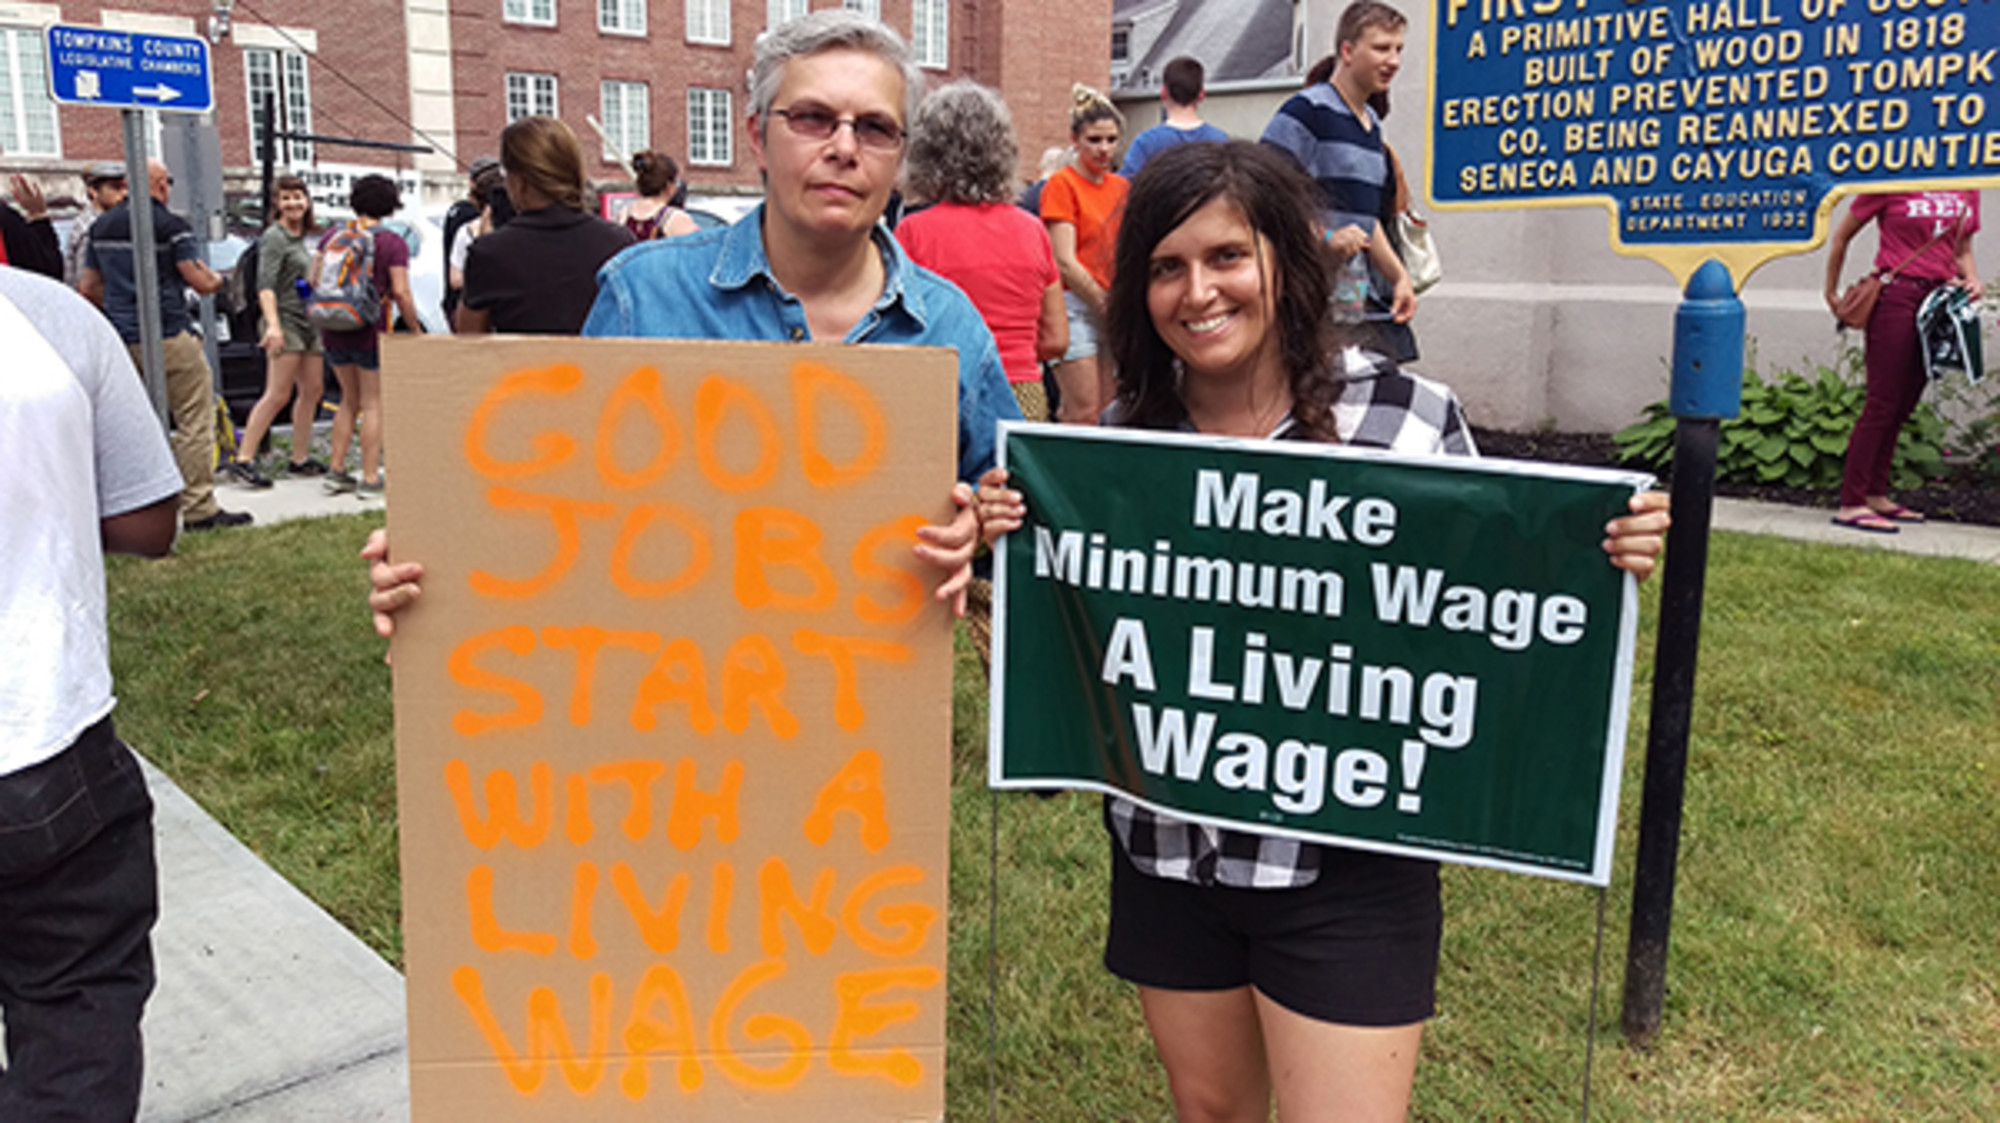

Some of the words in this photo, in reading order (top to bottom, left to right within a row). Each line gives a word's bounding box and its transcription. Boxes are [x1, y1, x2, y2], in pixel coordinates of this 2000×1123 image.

[53, 30, 133, 54] TOMPKINS
[142, 39, 201, 59] COUNTY
[1467, 30, 1486, 58] A
[1501, 7, 1668, 54] PRIMITIVE
[1687, 0, 1781, 33] HALL
[1801, 0, 1846, 20] OF
[1525, 50, 1613, 86] BUILT
[1631, 44, 1674, 75] OF
[1696, 30, 1803, 69] WOOD
[1824, 23, 1860, 58] IN
[1881, 13, 1965, 51] 1818
[1443, 89, 1595, 127] ERECTION
[1610, 66, 1828, 114] PREVENTED
[1848, 48, 1998, 94] TOMPK
[1499, 128, 1547, 155] CO.
[1565, 118, 1661, 152] BEING
[1678, 99, 1909, 145] REANNEXED
[1932, 93, 1985, 128] TO
[1460, 159, 1577, 192] SENECA
[1590, 154, 1658, 185] AND
[1671, 145, 1812, 181] CAYUGA
[1828, 131, 2000, 172] COUNTIE
[1629, 194, 1684, 211] STATE
[1701, 190, 1807, 209] EDUCATION
[1626, 213, 1746, 231] DEPARTMENT
[464, 360, 888, 492] GOOD
[1193, 468, 1398, 546] Make
[468, 484, 931, 624] JOBS
[1034, 526, 1344, 616] Minimum
[1371, 562, 1588, 650] Wage
[447, 623, 914, 740] START
[1101, 617, 1156, 691] A
[1187, 625, 1478, 748] Living
[444, 758, 745, 850] WITH
[803, 747, 891, 852] A
[1131, 703, 1430, 814] Wage!
[466, 855, 938, 960] LIVING
[451, 958, 940, 1099] WAGE
